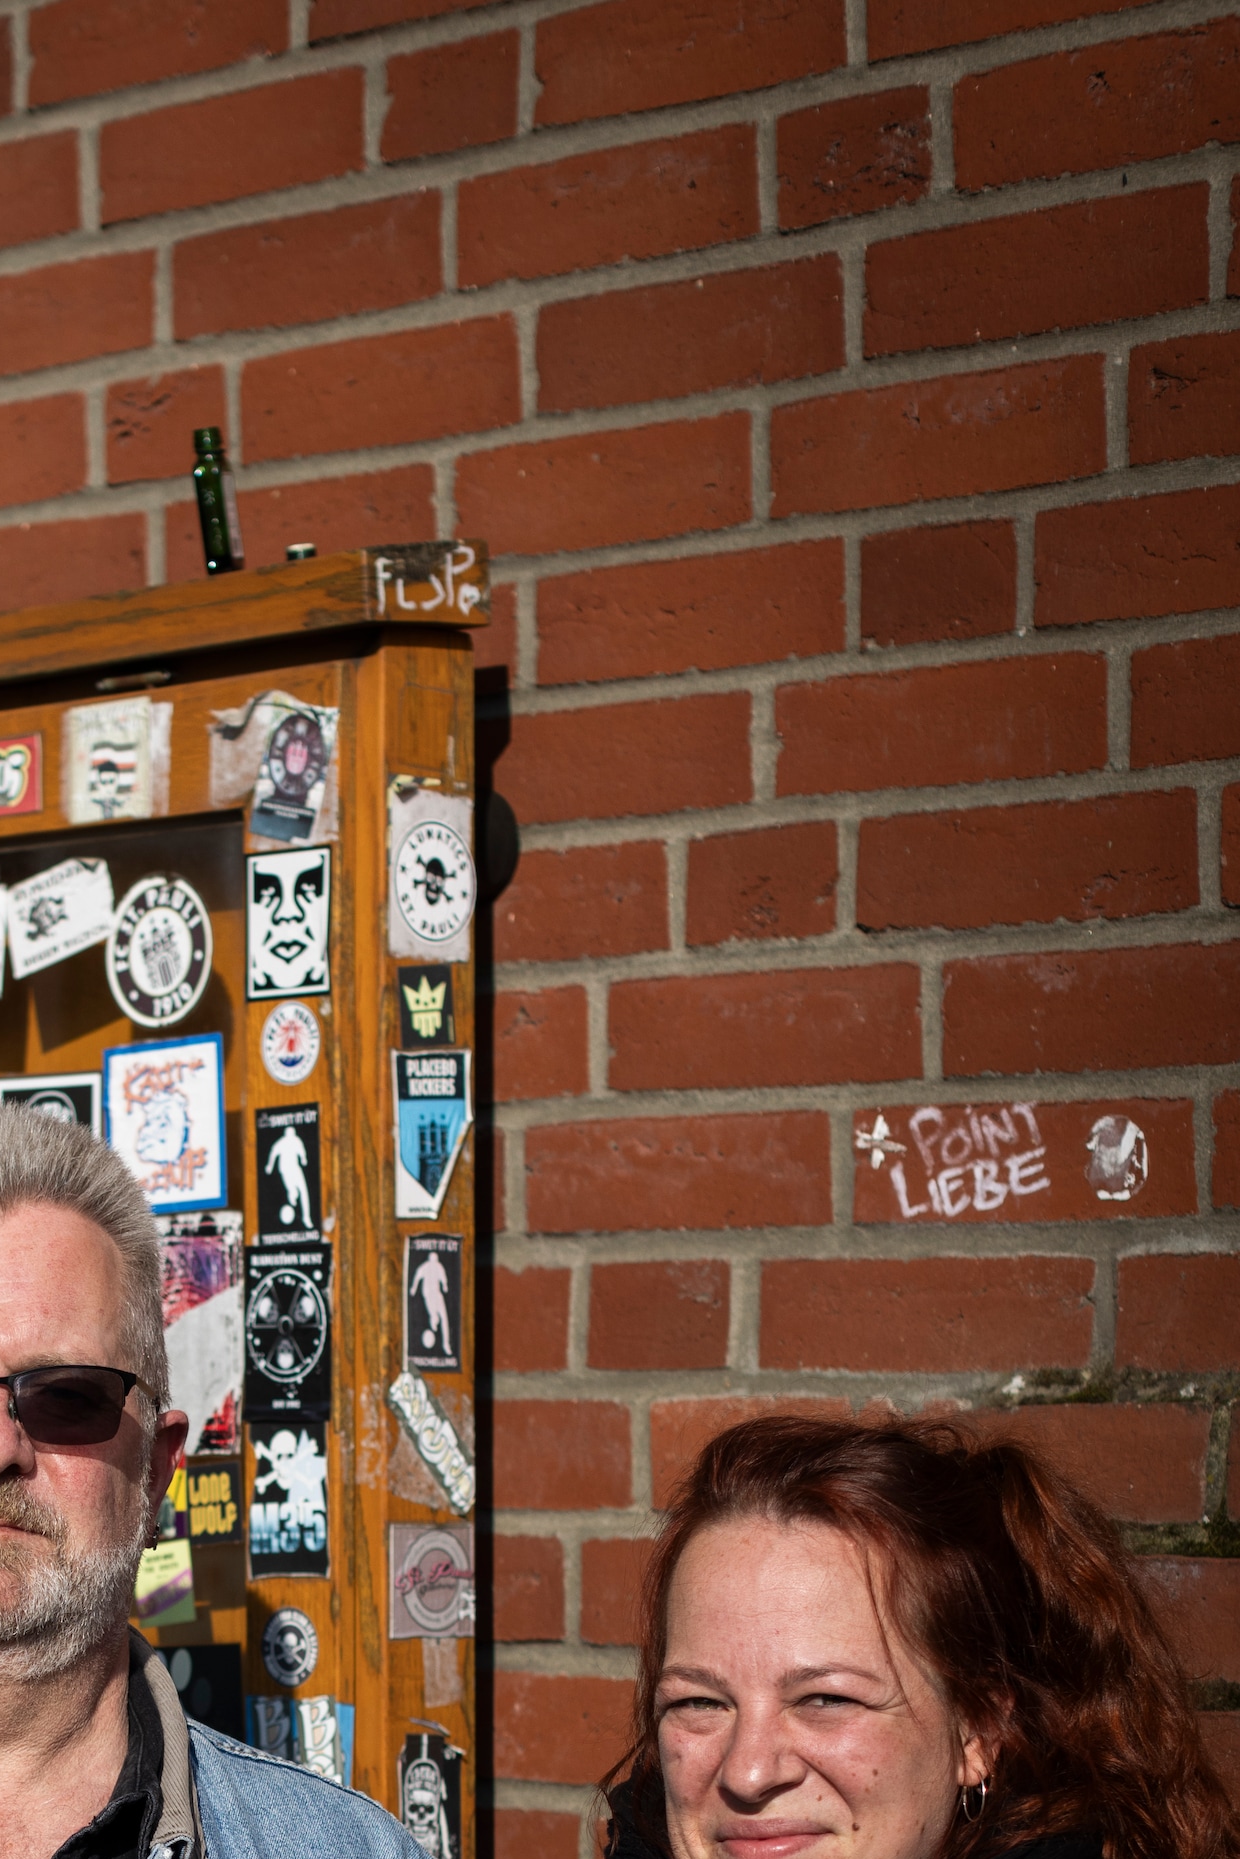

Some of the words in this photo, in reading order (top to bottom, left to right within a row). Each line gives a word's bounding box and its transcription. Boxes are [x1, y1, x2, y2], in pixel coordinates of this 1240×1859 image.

[408, 828, 467, 871] LUNATICS
[115, 944, 130, 973] FC
[145, 885, 202, 929] PAULI
[421, 912, 461, 935] PAULI
[152, 982, 194, 1018] 1910
[405, 1058, 458, 1078] PLACEBO
[408, 1078, 457, 1097] KICKERS
[909, 1102, 1043, 1176] POINT
[890, 1147, 1051, 1218] LIEBE
